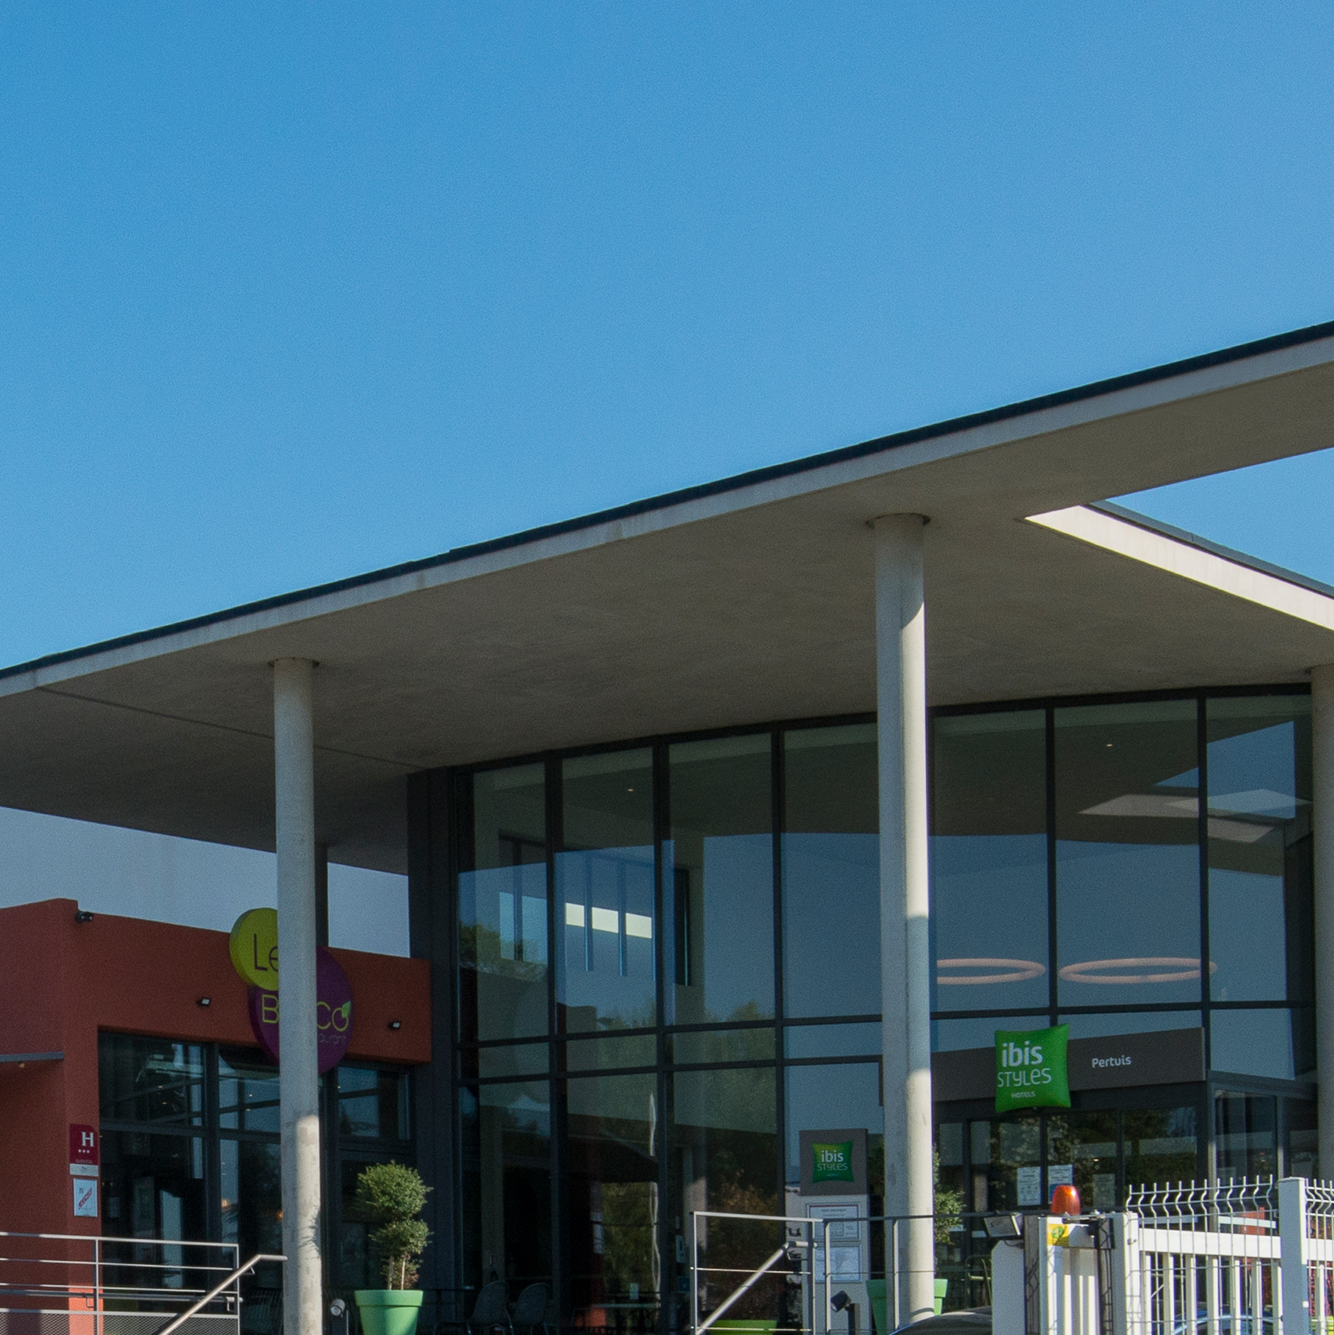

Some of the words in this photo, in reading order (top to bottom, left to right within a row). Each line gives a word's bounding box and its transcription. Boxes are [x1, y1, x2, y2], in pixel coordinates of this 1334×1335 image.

[1001, 1040, 1044, 1068] ibis
[1091, 1054, 1132, 1069] Pertuis
[1011, 1091, 1036, 1099] HOTELS
[81, 1131, 95, 1148] H
[821, 1150, 844, 1163] ibis
